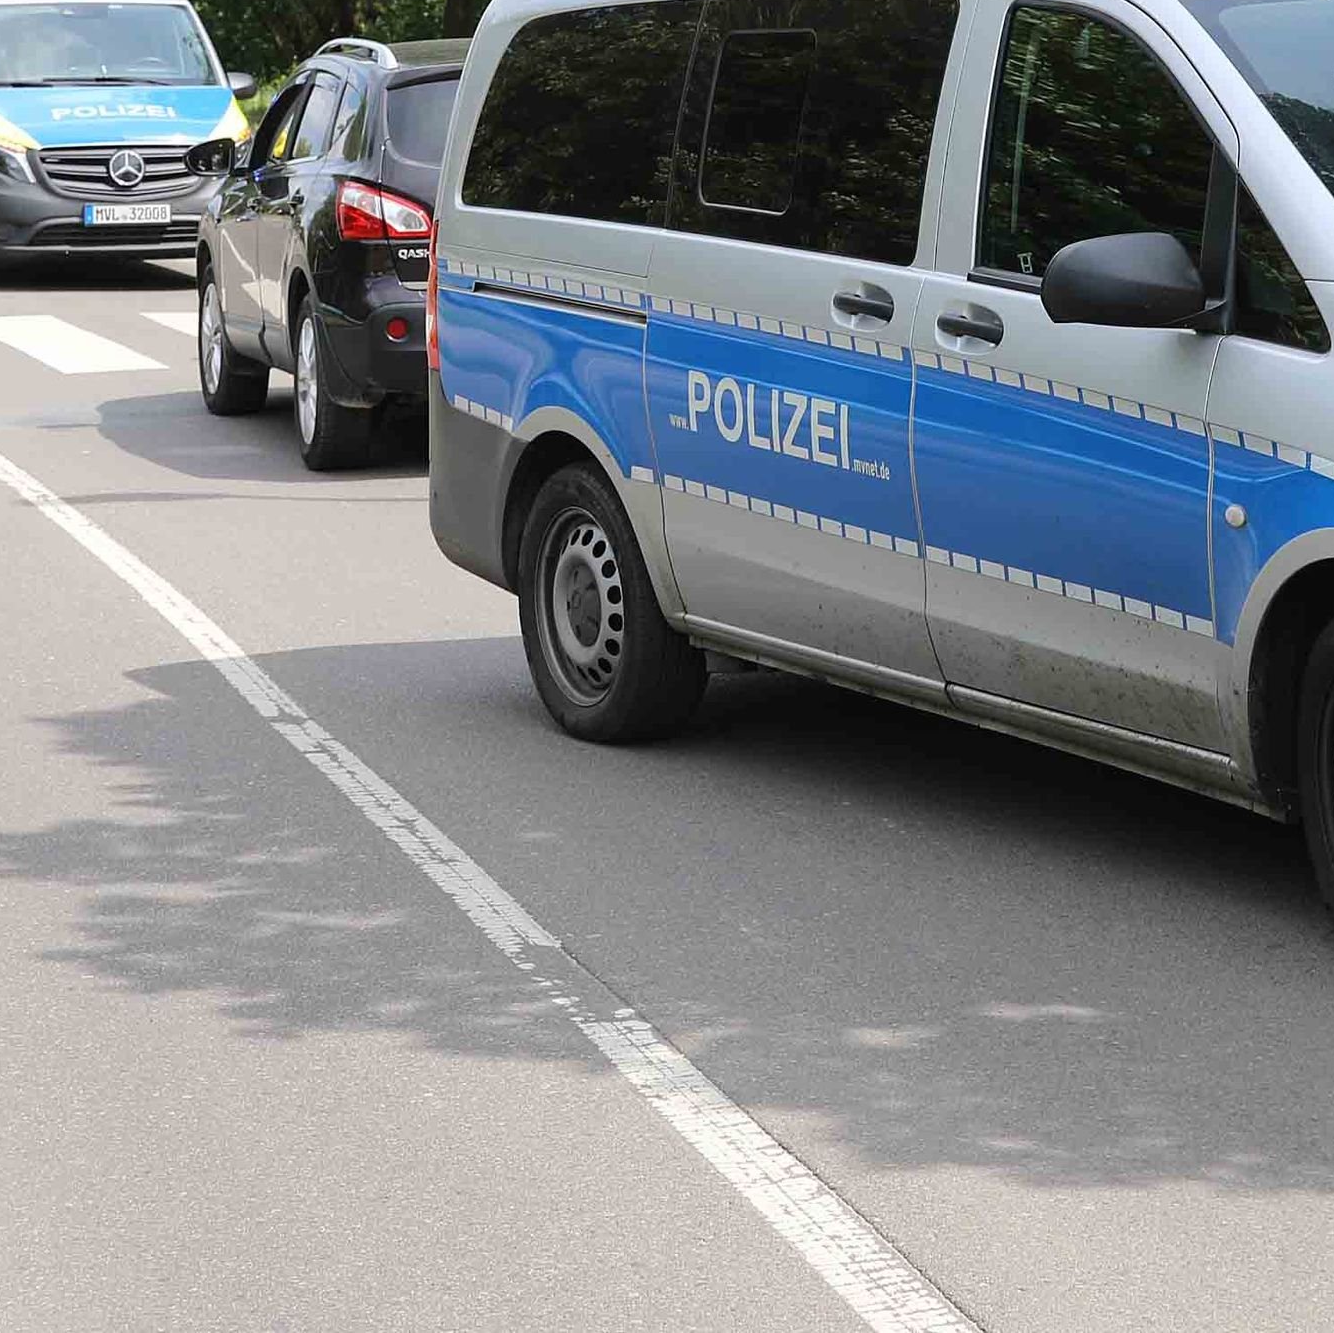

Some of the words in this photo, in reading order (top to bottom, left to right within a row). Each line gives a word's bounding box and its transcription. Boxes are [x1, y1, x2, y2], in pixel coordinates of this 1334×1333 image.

[51, 103, 177, 122] POLIZEI
[96, 206, 119, 222] MVL
[129, 206, 167, 221] 32008
